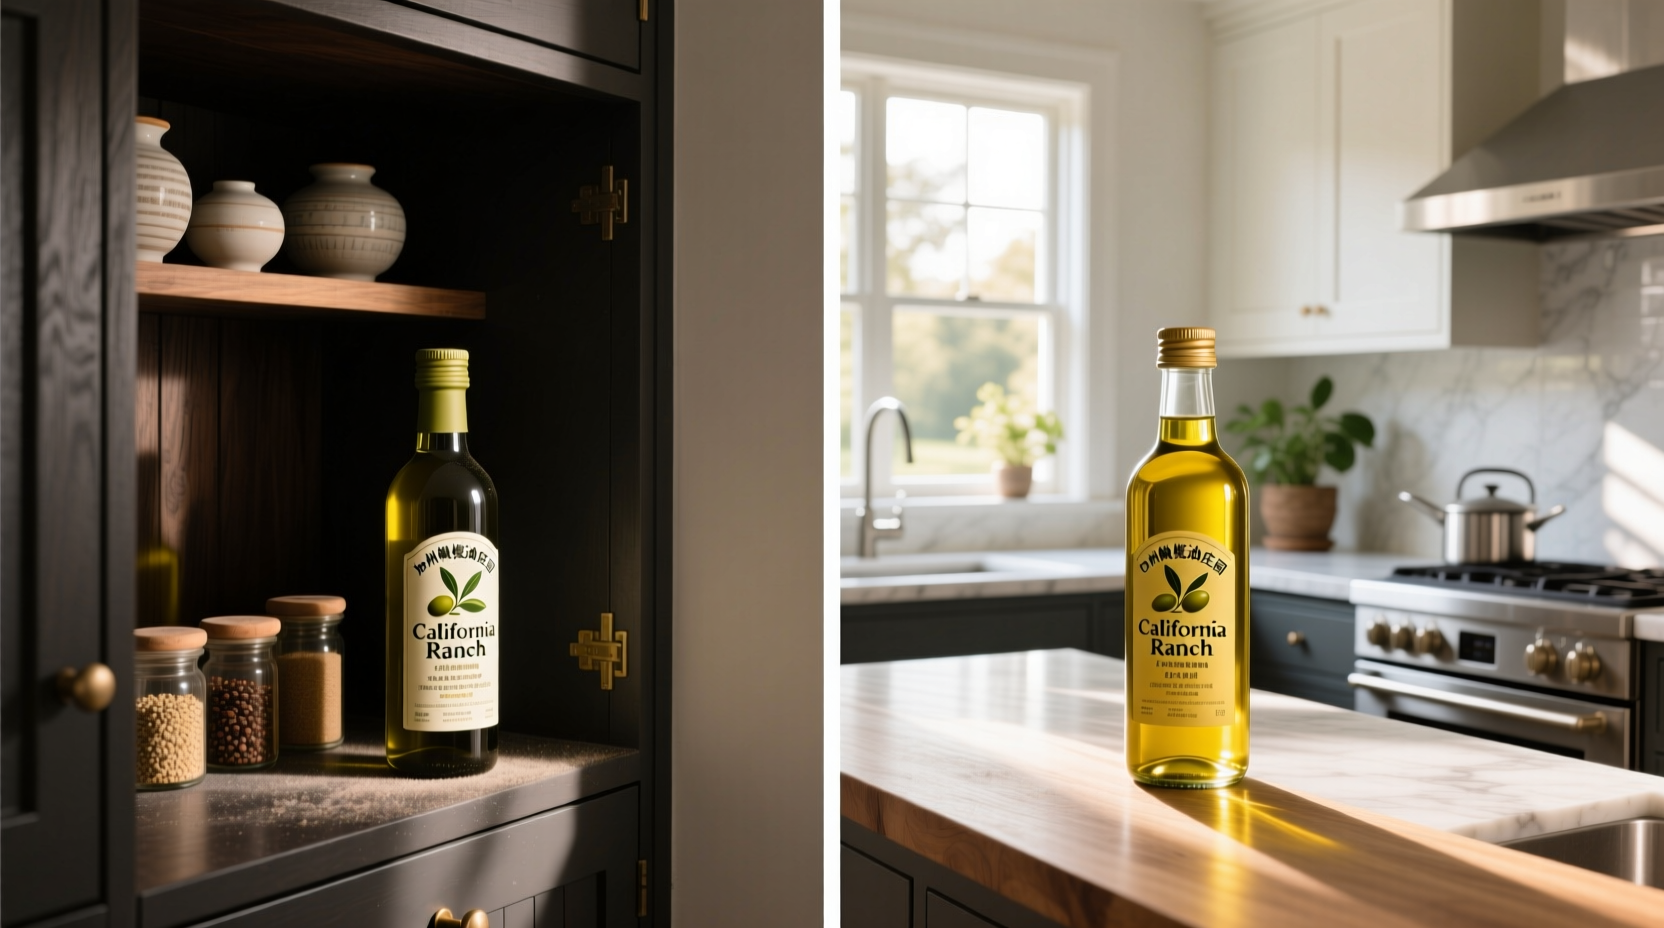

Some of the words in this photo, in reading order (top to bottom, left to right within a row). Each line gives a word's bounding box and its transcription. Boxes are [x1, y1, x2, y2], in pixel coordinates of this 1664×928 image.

[412, 621, 496, 640] California
[1138, 618, 1227, 638] California
[426, 640, 486, 660] Ranch
[1150, 638, 1213, 656] Ranch
